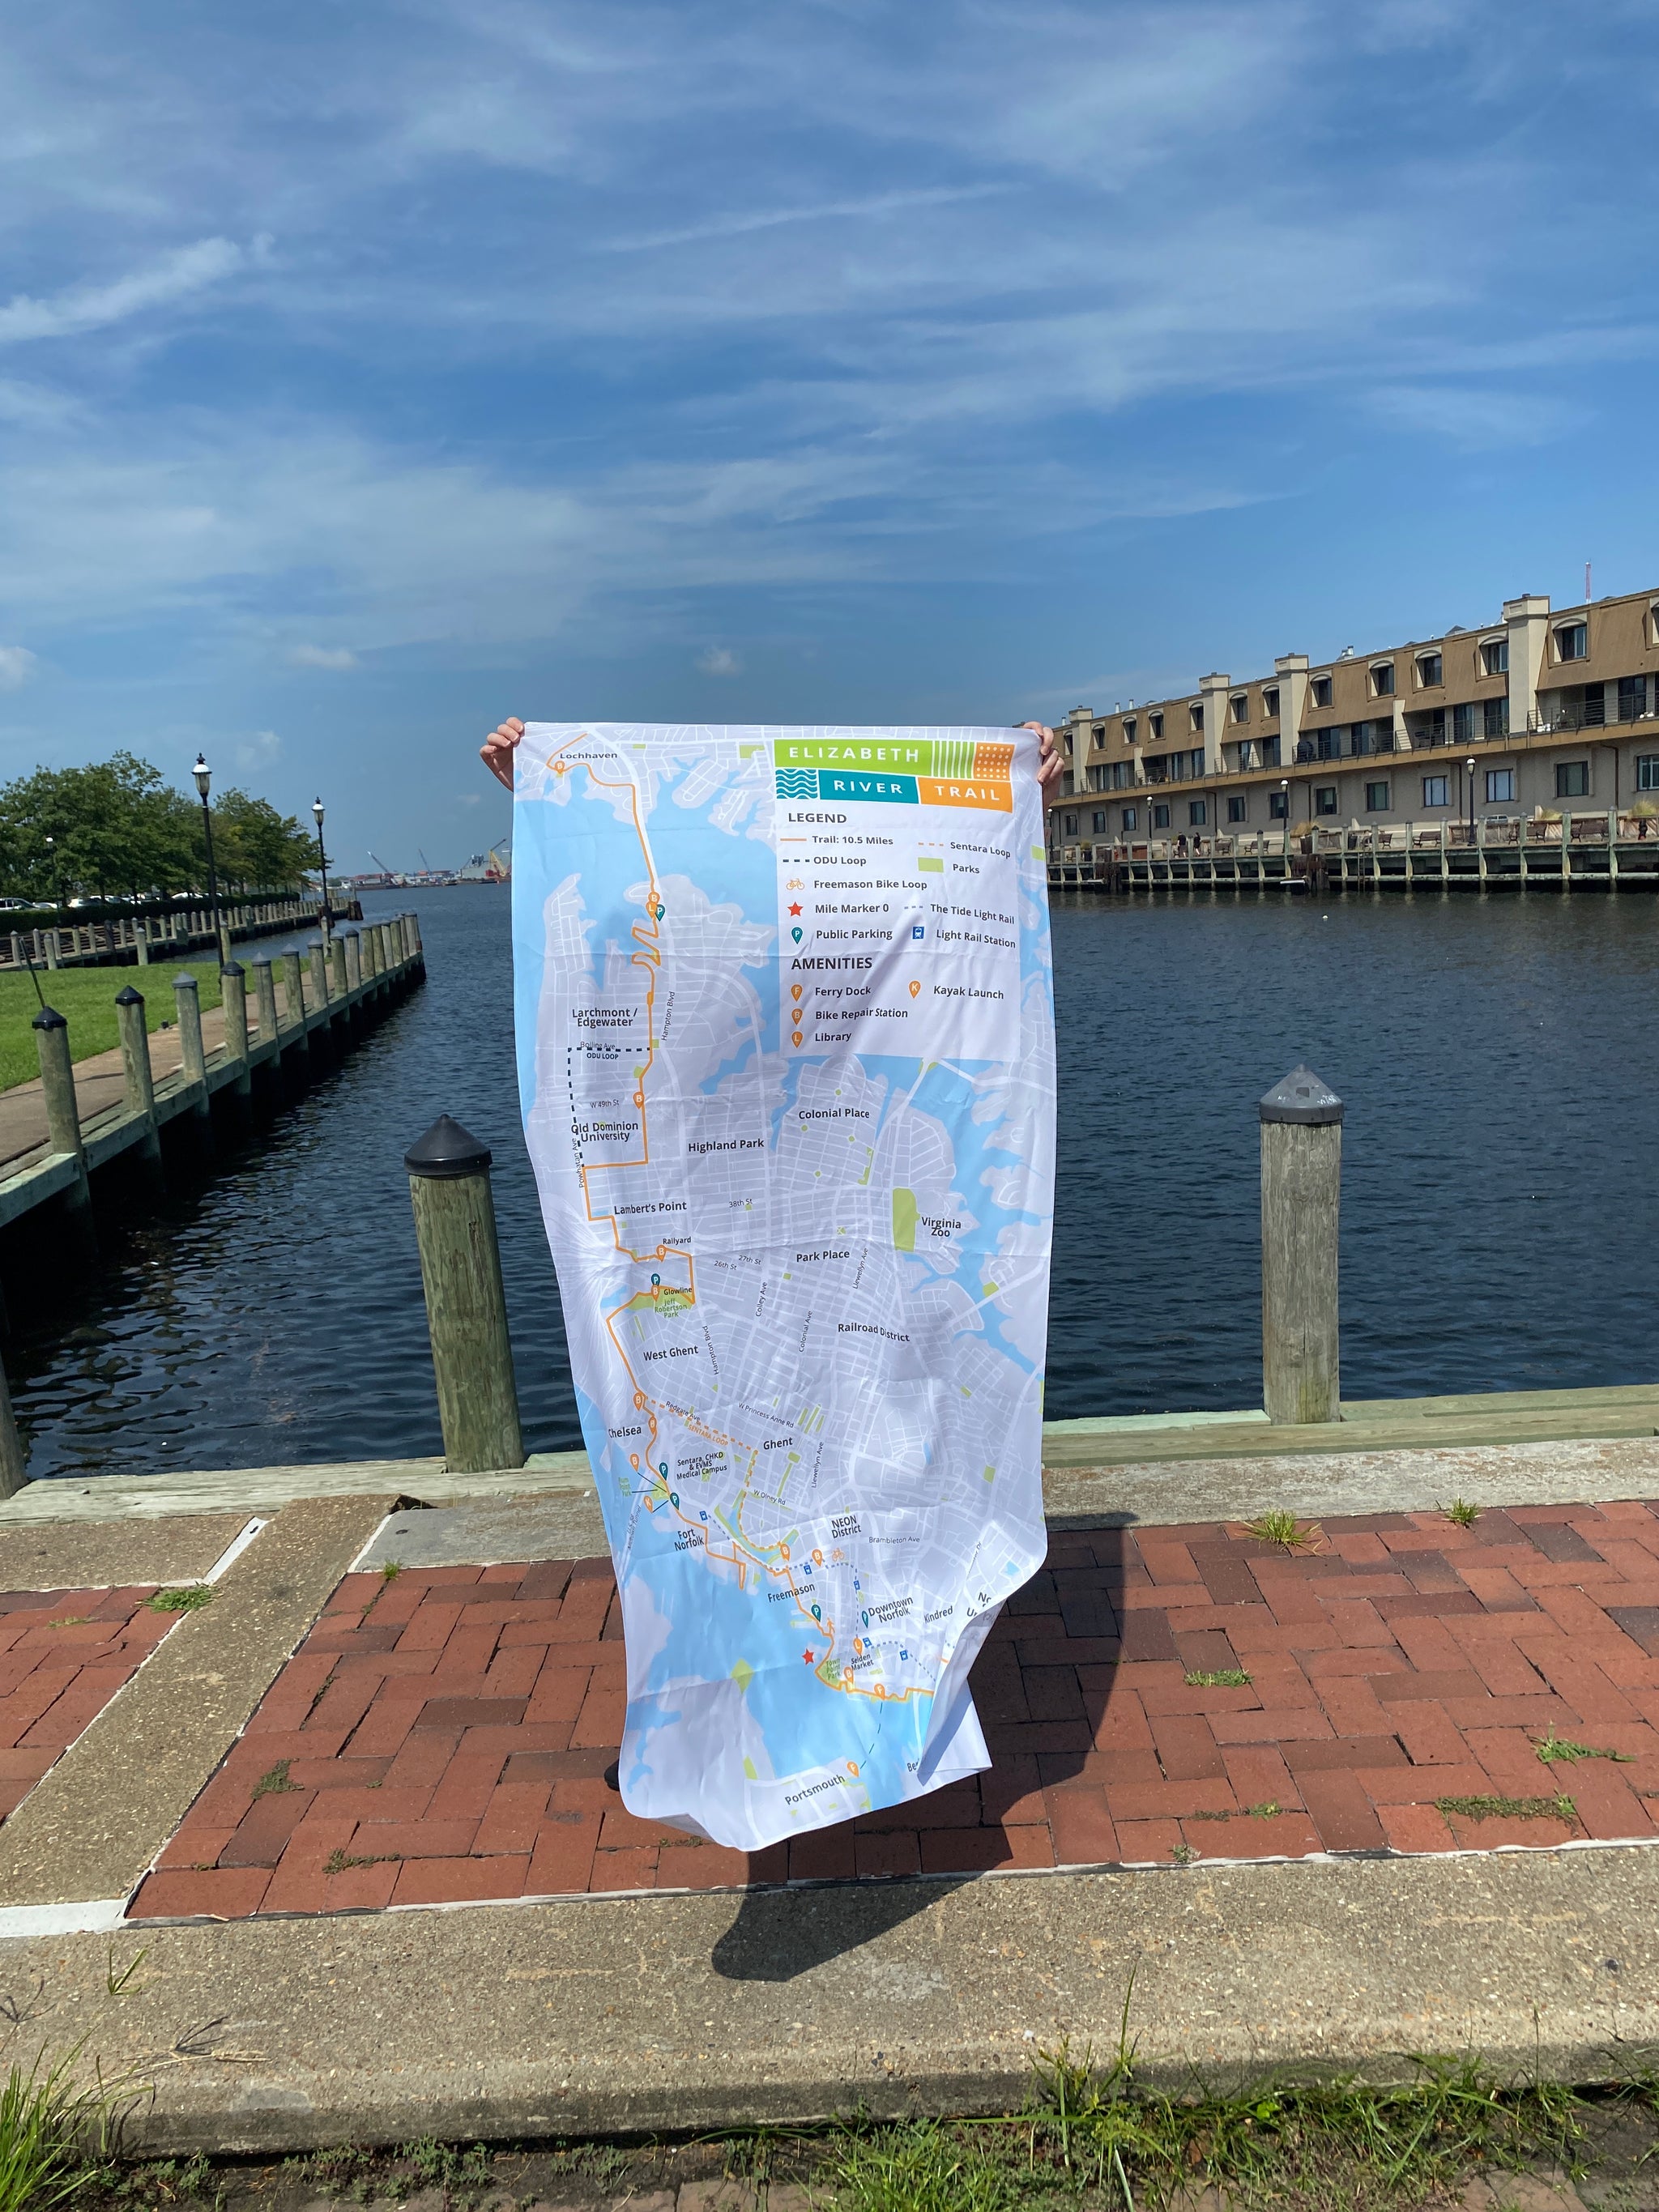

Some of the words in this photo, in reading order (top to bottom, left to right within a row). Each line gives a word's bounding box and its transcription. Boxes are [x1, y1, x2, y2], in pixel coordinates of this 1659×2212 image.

[789, 747, 919, 762] ELIZABETH
[834, 780, 902, 794] RIVER
[934, 786, 1000, 801] TRAIL
[788, 812, 847, 823] LEGEND
[866, 837, 893, 845] Miles
[950, 842, 988, 853] Sentara
[990, 846, 1011, 859] Loop
[813, 856, 838, 865] ODU
[841, 856, 867, 866] Loop
[953, 864, 979, 874] Parks
[814, 880, 873, 889] Freemason
[876, 880, 898, 888] Bike
[902, 880, 928, 890] Loop
[815, 905, 838, 914] Mile
[841, 904, 880, 913] Marker
[931, 904, 948, 914] The
[951, 906, 971, 917] Tide
[974, 909, 997, 923] Light
[999, 912, 1014, 924] Rail
[817, 930, 848, 939] Public
[852, 929, 893, 940] Parking
[936, 930, 962, 942] Light
[962, 932, 982, 944] Rail
[984, 935, 1016, 948] Station
[791, 957, 872, 970] AMENITIES
[815, 987, 842, 998] Ferry
[846, 987, 871, 995] Dock
[934, 986, 966, 998] Kayak
[969, 988, 1004, 999] Launch
[572, 1008, 630, 1018] Larchmont
[661, 1009, 672, 1041] Hampton
[667, 991, 675, 1006] Blvd
[816, 1010, 838, 1020] Bike
[842, 1008, 873, 1021] Repair
[876, 1008, 908, 1018] Station
[578, 1017, 633, 1029] Edgewater
[815, 1032, 851, 1042] Library
[799, 1108, 841, 1119] Colonial
[845, 1108, 869, 1118] Place
[593, 1122, 638, 1132] Dominion
[581, 1132, 629, 1142] University
[689, 1141, 736, 1153] Highland
[740, 1139, 764, 1149] Park
[659, 1201, 687, 1212] Point
[729, 1200, 744, 1208] 38th
[922, 1217, 962, 1230] Virginia
[932, 1227, 950, 1237] Zoo
[796, 1252, 820, 1262] Park
[823, 1251, 850, 1259] Place
[714, 1260, 729, 1268] 26th
[853, 1261, 864, 1289] Llewellyn
[664, 1287, 692, 1295] Glowline
[655, 1304, 687, 1313] Robertson
[756, 1294, 766, 1317] Colley
[702, 1326, 711, 1340] Blvd
[838, 1323, 878, 1333] Railroad
[881, 1328, 910, 1341] District
[799, 1325, 808, 1353] Colonial
[643, 1350, 667, 1361] West
[670, 1345, 698, 1356] Ghent
[707, 1341, 719, 1375] Hampton
[666, 1401, 689, 1415] Redgate
[689, 1413, 700, 1421] Ave
[745, 1405, 770, 1419] Princess
[770, 1416, 785, 1426] Anne
[608, 1426, 642, 1438] Chelsea
[689, 1425, 710, 1438] SENTARA
[712, 1435, 728, 1447] LOOP
[763, 1437, 792, 1450] Ghent
[677, 1456, 702, 1466] Sentara,
[706, 1452, 723, 1461] CHKD
[696, 1460, 712, 1469] EVMS
[677, 1469, 700, 1480] Medical
[702, 1464, 727, 1475] Campus
[812, 1455, 821, 1488] Llewellyn
[759, 1492, 777, 1502] Olney
[831, 1515, 856, 1528] NEON
[678, 1528, 695, 1539] Fort
[832, 1524, 861, 1538] District
[675, 1536, 704, 1551] Norfolk
[768, 1583, 815, 1602] Freemason
[868, 1597, 913, 1617] Downtown
[879, 1608, 911, 1623] Norfolk
[924, 1605, 953, 1624] Kindred
[851, 1654, 870, 1664] Selden
[851, 1660, 874, 1670] Market
[785, 1775, 846, 1805] Portsmouth
